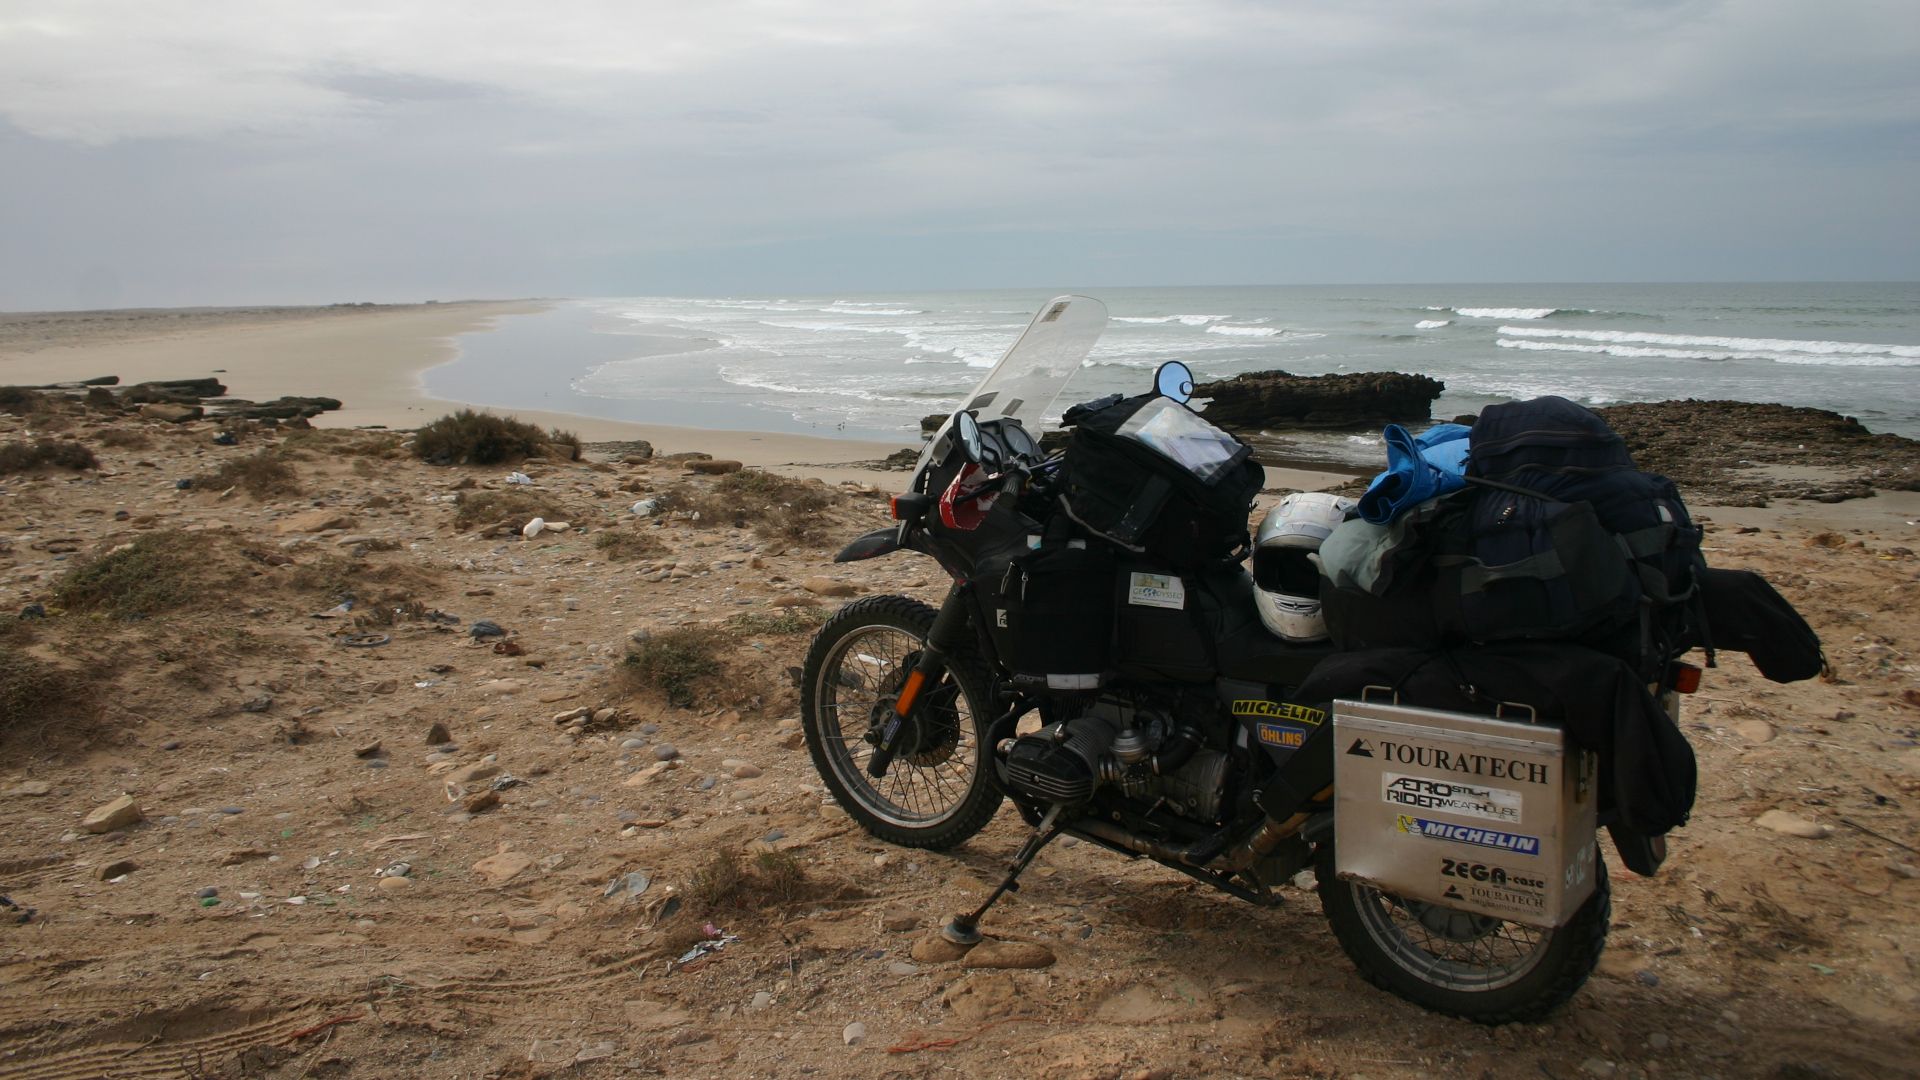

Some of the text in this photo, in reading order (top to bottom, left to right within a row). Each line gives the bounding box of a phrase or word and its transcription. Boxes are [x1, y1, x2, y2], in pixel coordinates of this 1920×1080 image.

[1233, 701, 1323, 723] MICHELIN
[1260, 724, 1303, 746] ÖHLINS
[1380, 741, 1548, 784] TOURATECH
[1423, 821, 1536, 851] MICHELIN
[1470, 886, 1544, 909] TOURATECH
